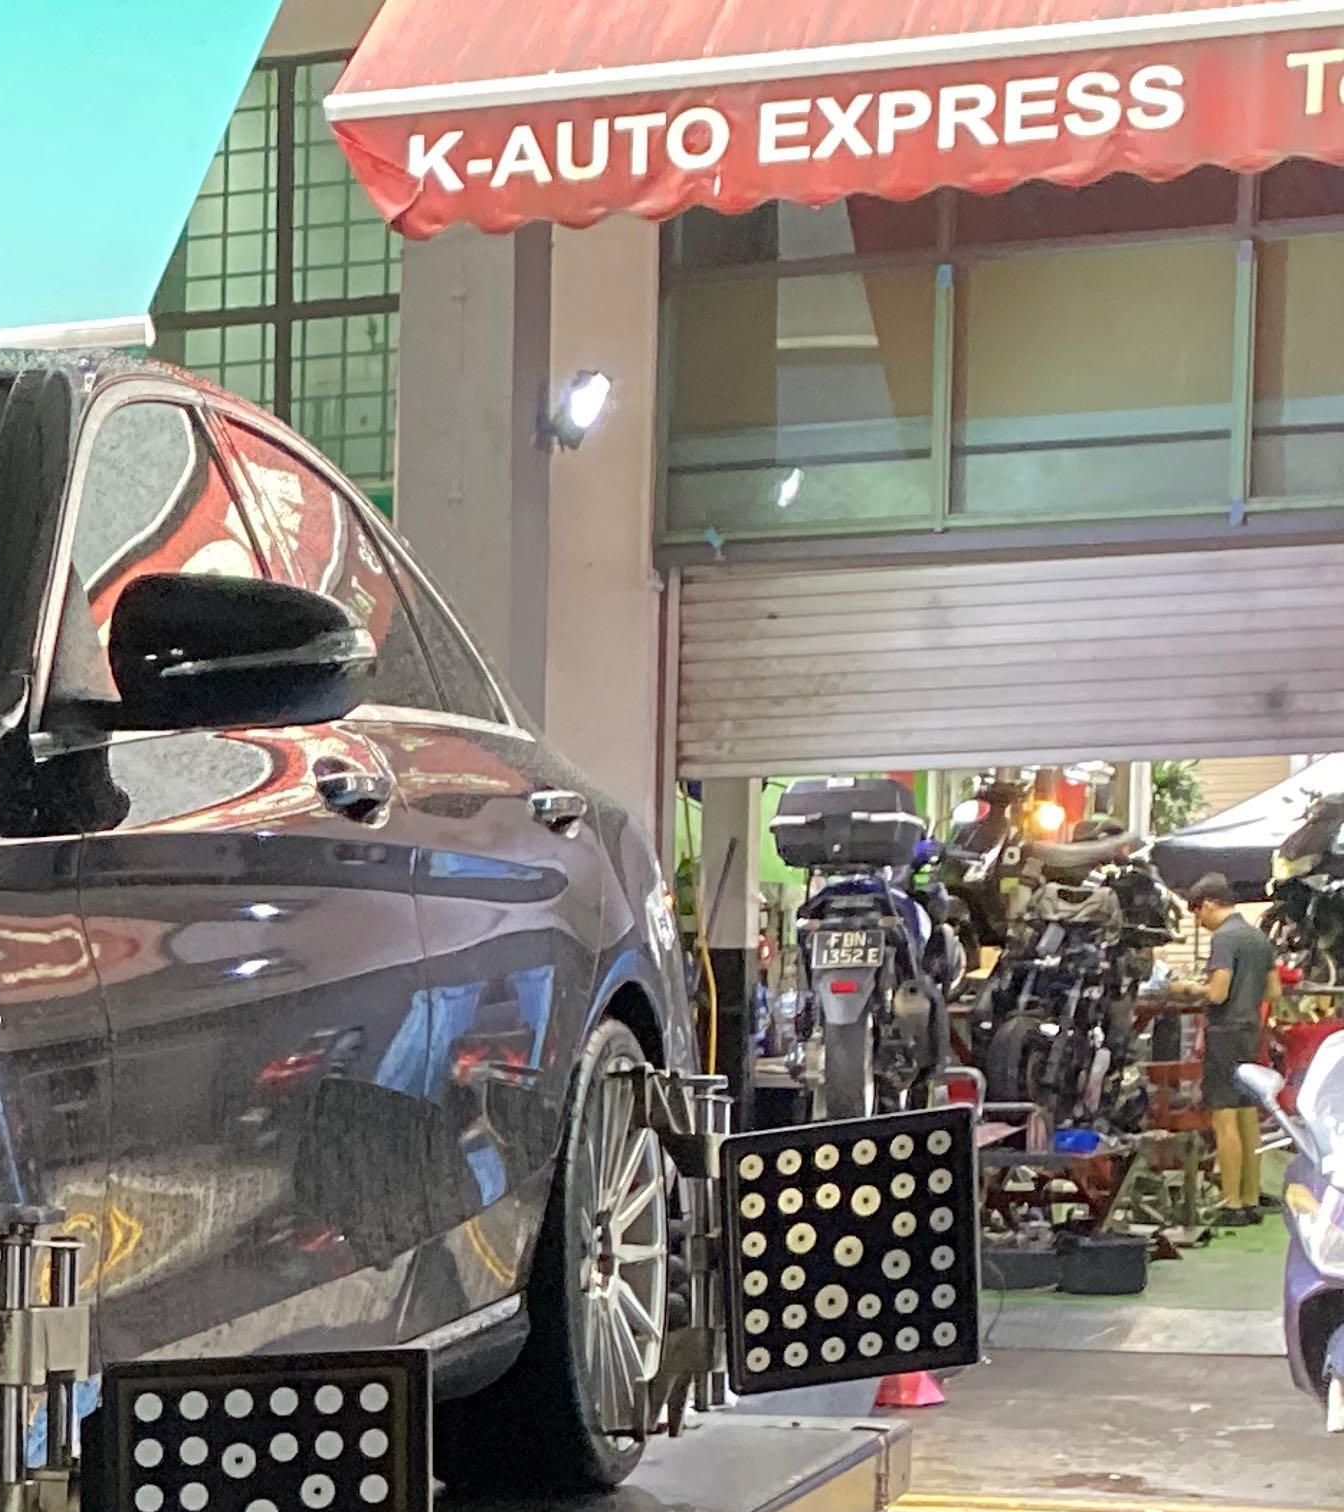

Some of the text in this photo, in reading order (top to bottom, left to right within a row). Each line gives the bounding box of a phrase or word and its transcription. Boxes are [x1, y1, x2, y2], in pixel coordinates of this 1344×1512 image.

[408, 48, 1344, 191] K-AUTO EXPRESS T
